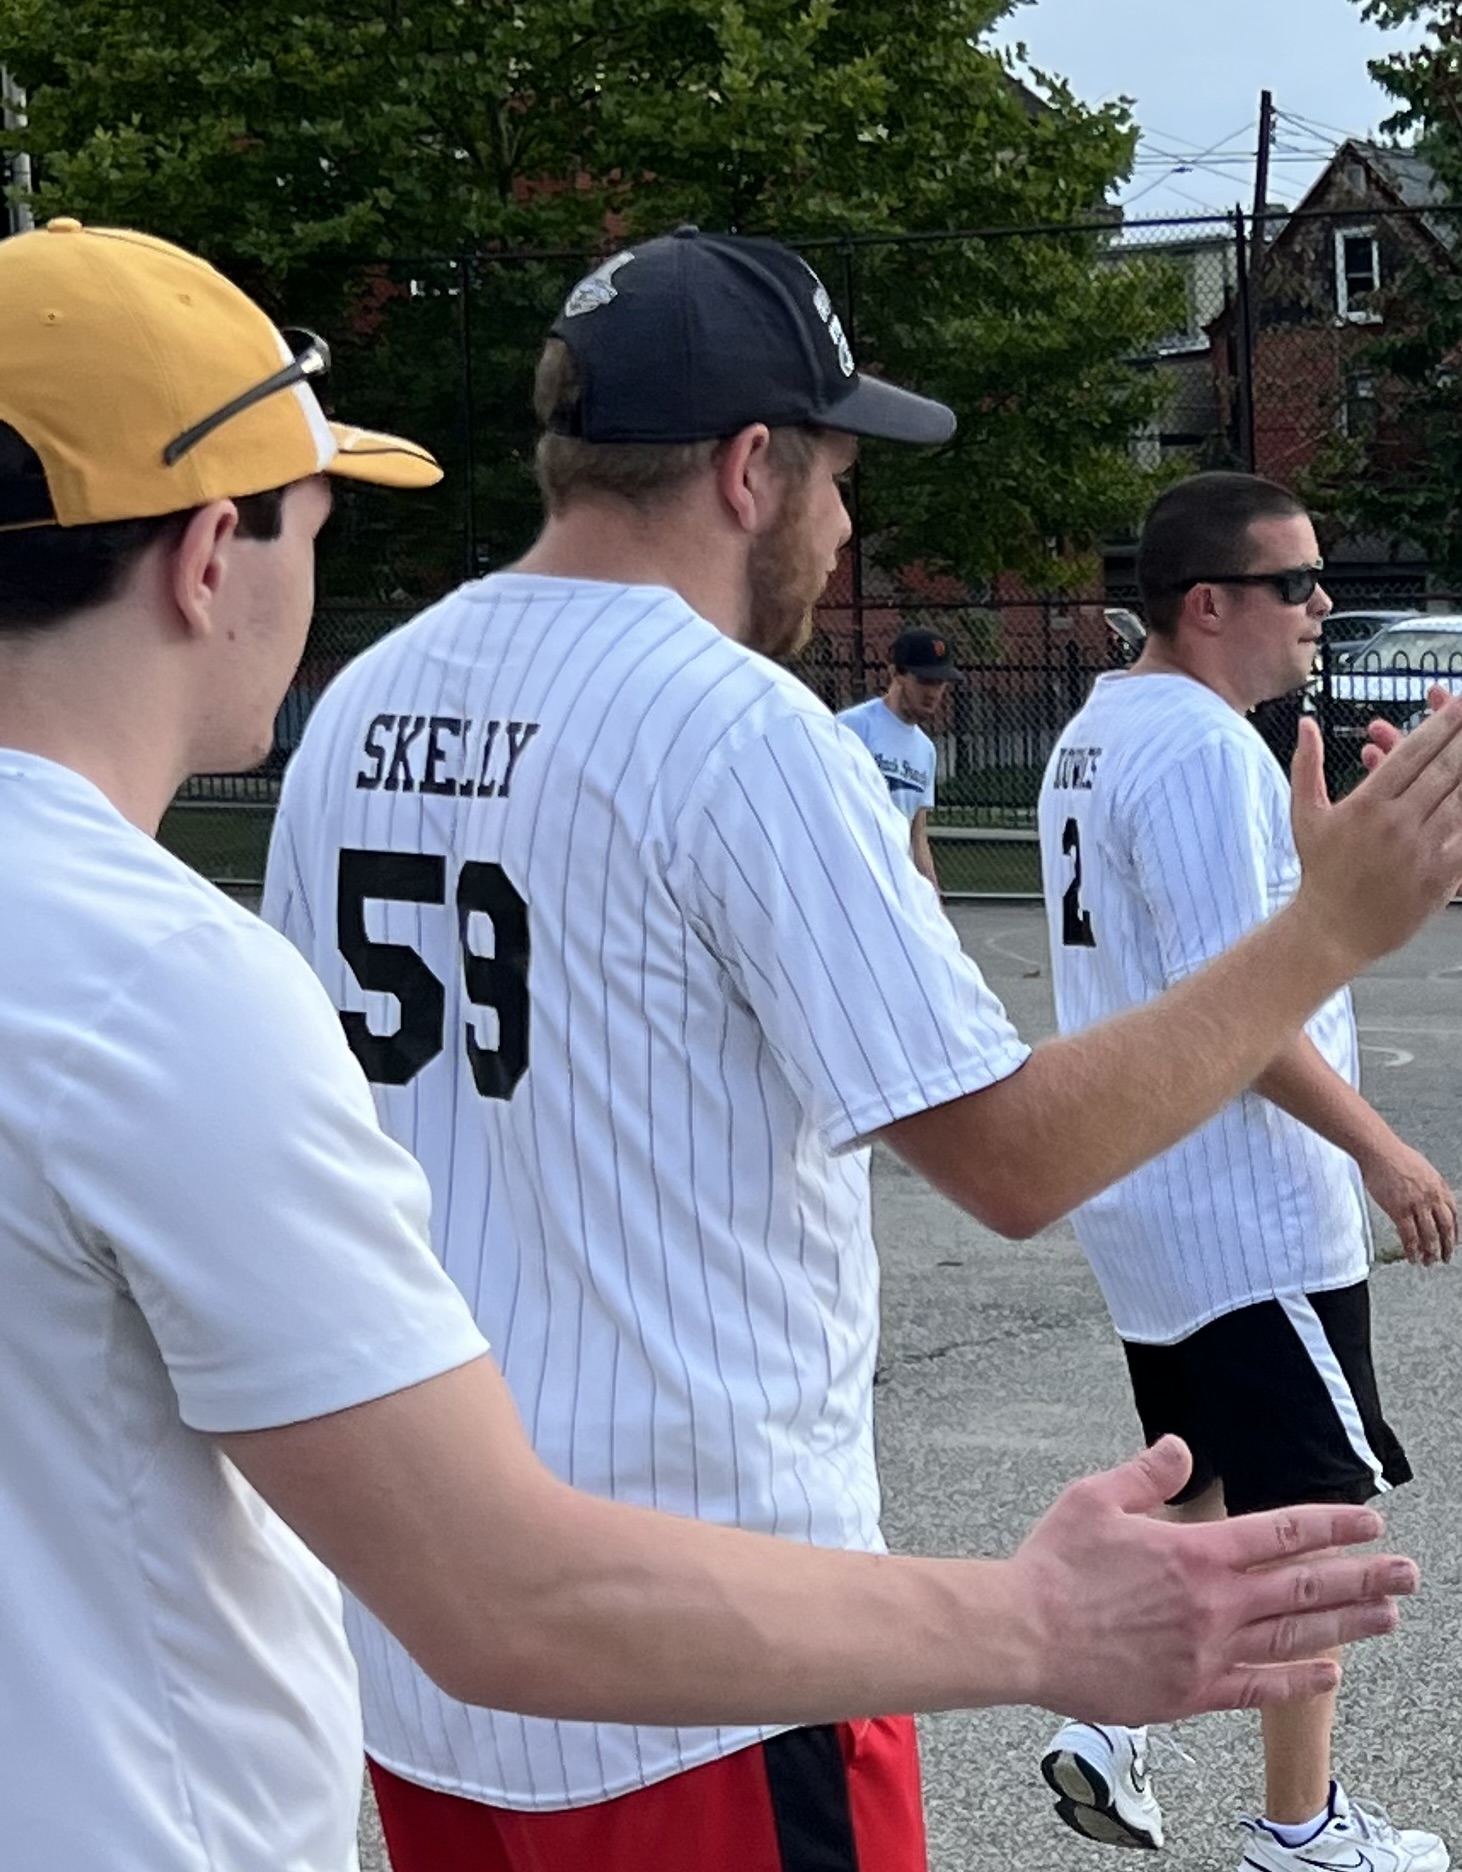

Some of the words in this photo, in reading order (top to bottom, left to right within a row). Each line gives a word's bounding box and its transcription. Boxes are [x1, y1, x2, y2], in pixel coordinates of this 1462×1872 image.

[356, 713, 540, 798] SKELLY
[1062, 817, 1096, 947] 2
[337, 847, 530, 1101] 59
